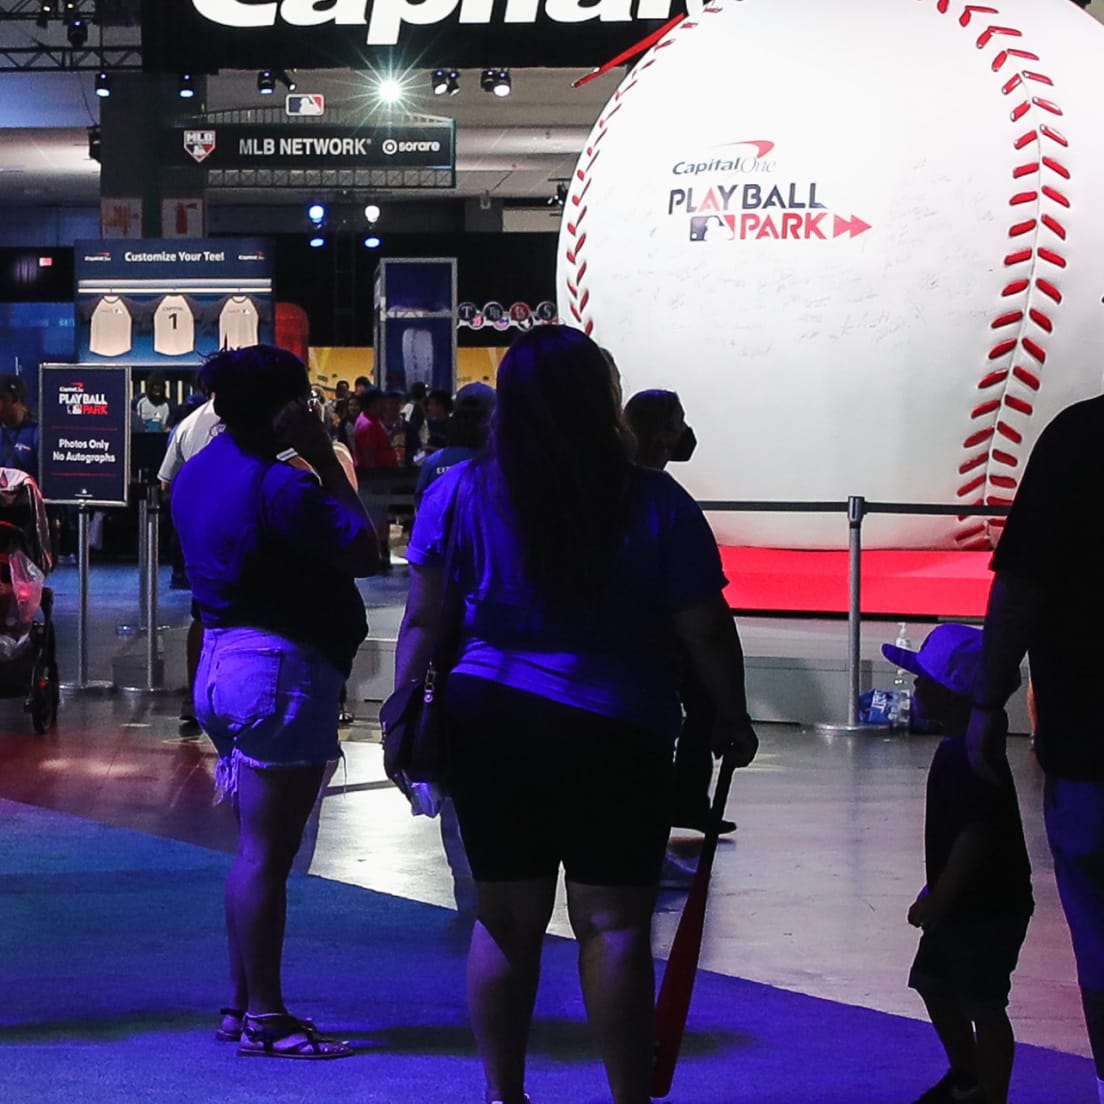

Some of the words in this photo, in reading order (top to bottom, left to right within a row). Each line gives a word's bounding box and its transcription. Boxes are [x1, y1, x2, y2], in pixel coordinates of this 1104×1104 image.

[239, 138, 275, 155] MLB
[398, 140, 441, 152] sorare
[739, 212, 829, 241] PARK
[124, 252, 177, 262] Customize
[179, 252, 203, 262] Your
[204, 252, 225, 262] Tee!
[167, 312, 177, 330] 1
[82, 404, 108, 415] PARK
[59, 438, 87, 449] Photos
[89, 439, 110, 450] Only
[52, 452, 64, 461] No
[66, 452, 116, 464] Autographs
